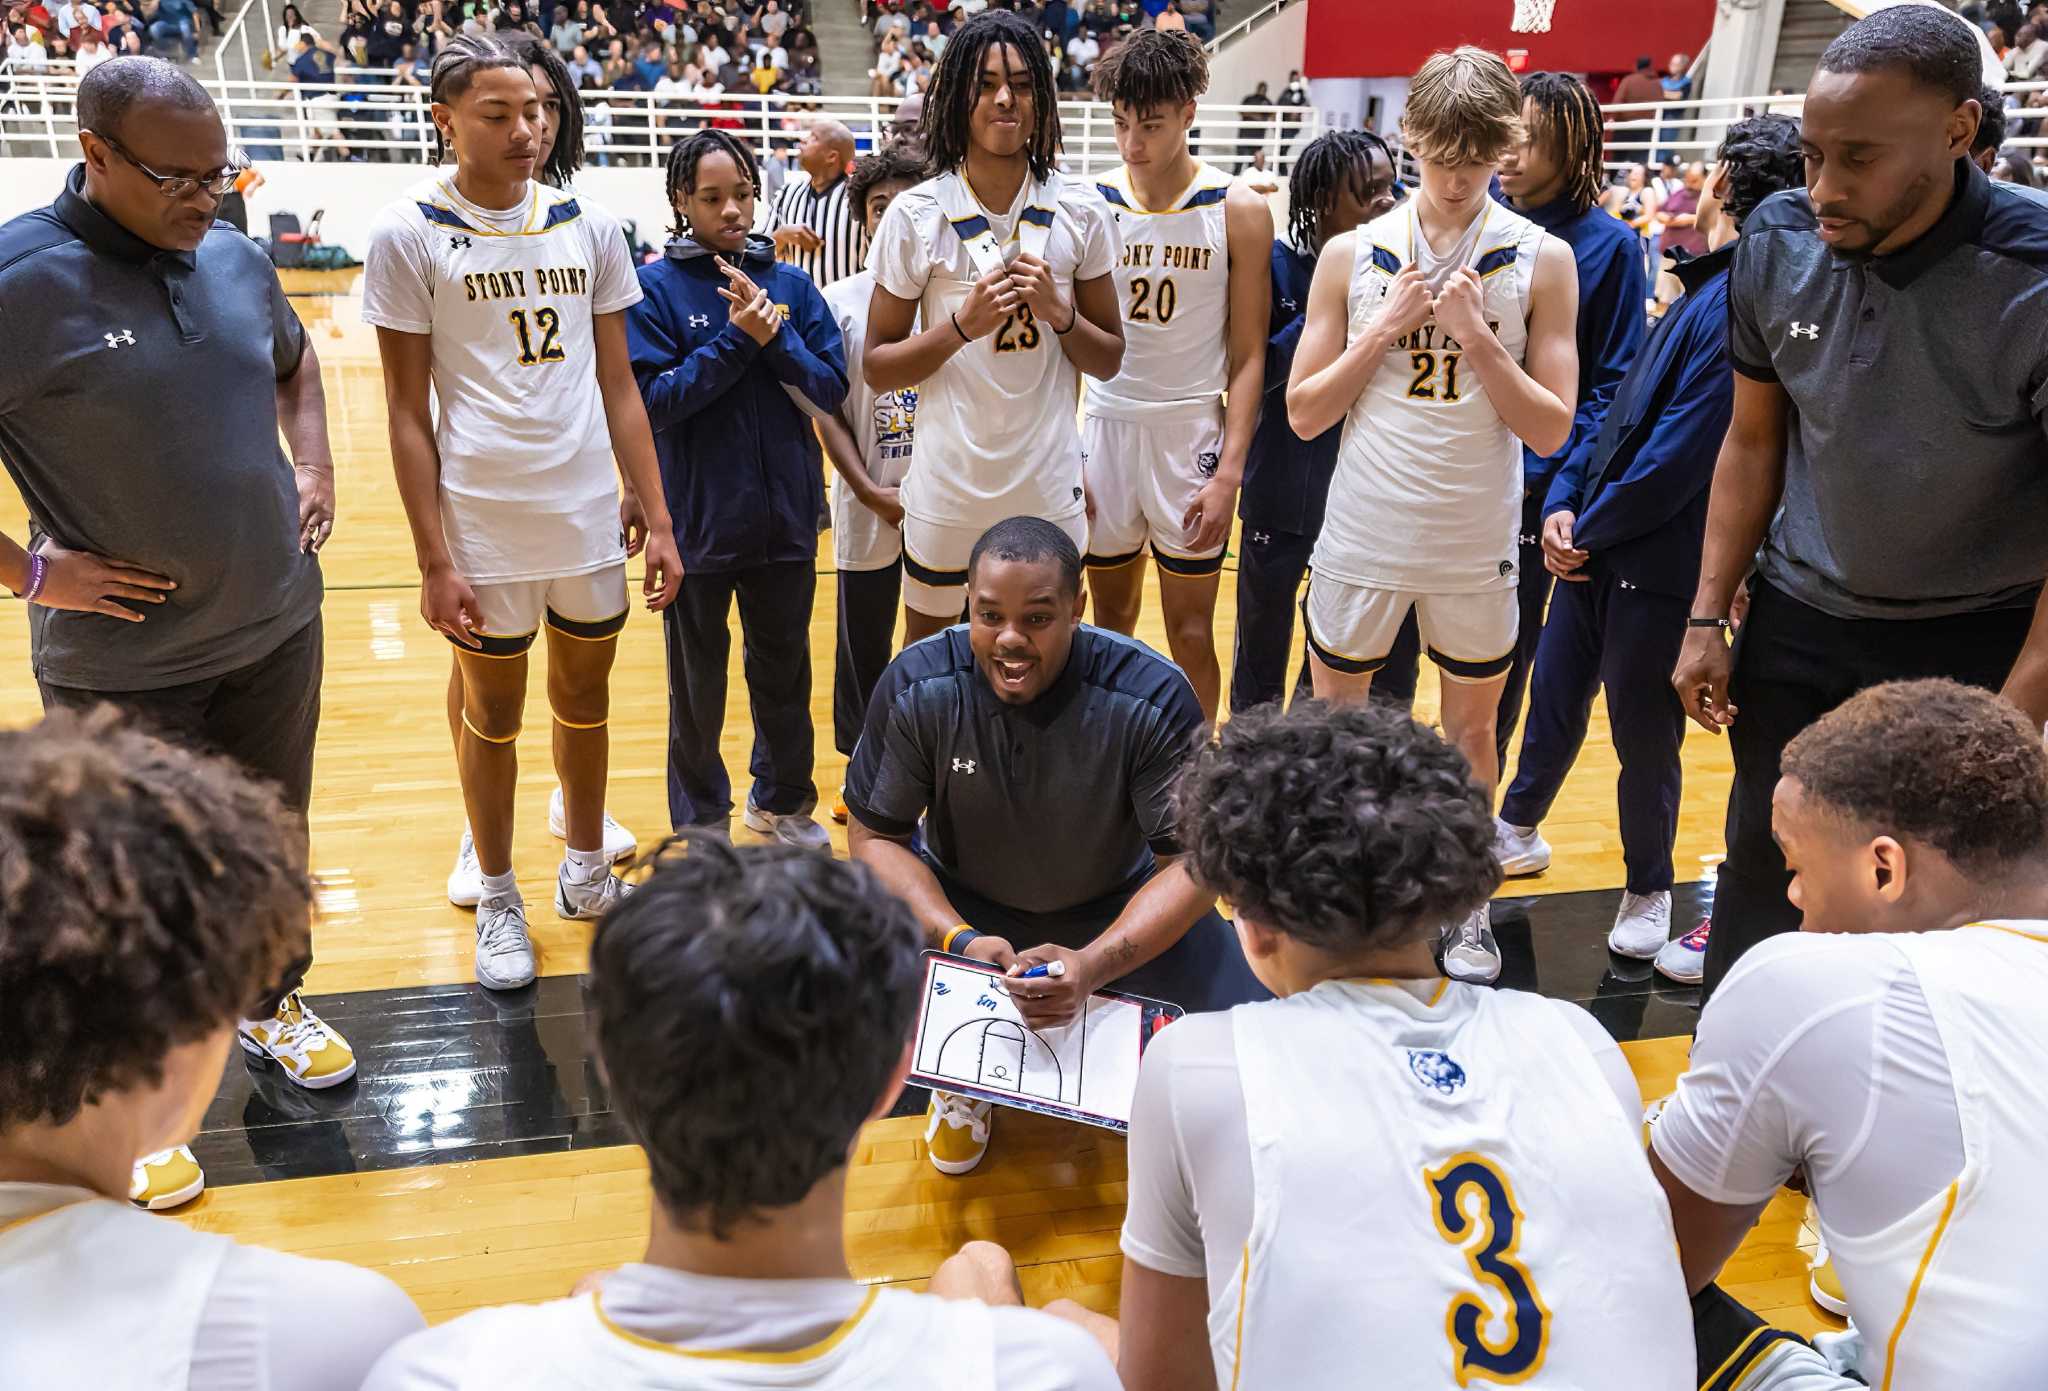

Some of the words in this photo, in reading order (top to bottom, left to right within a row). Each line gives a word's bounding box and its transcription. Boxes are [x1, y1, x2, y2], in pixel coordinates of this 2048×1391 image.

[1116, 244, 1154, 267] ONY
[1163, 245, 1212, 270] POINT
[464, 270, 526, 301] STONY
[535, 267, 588, 296] POINT
[1128, 276, 1176, 324] 20
[509, 306, 566, 366] 12
[995, 301, 1041, 352] 23
[1407, 350, 1462, 402] 21
[1423, 1150, 1554, 1389] 3
